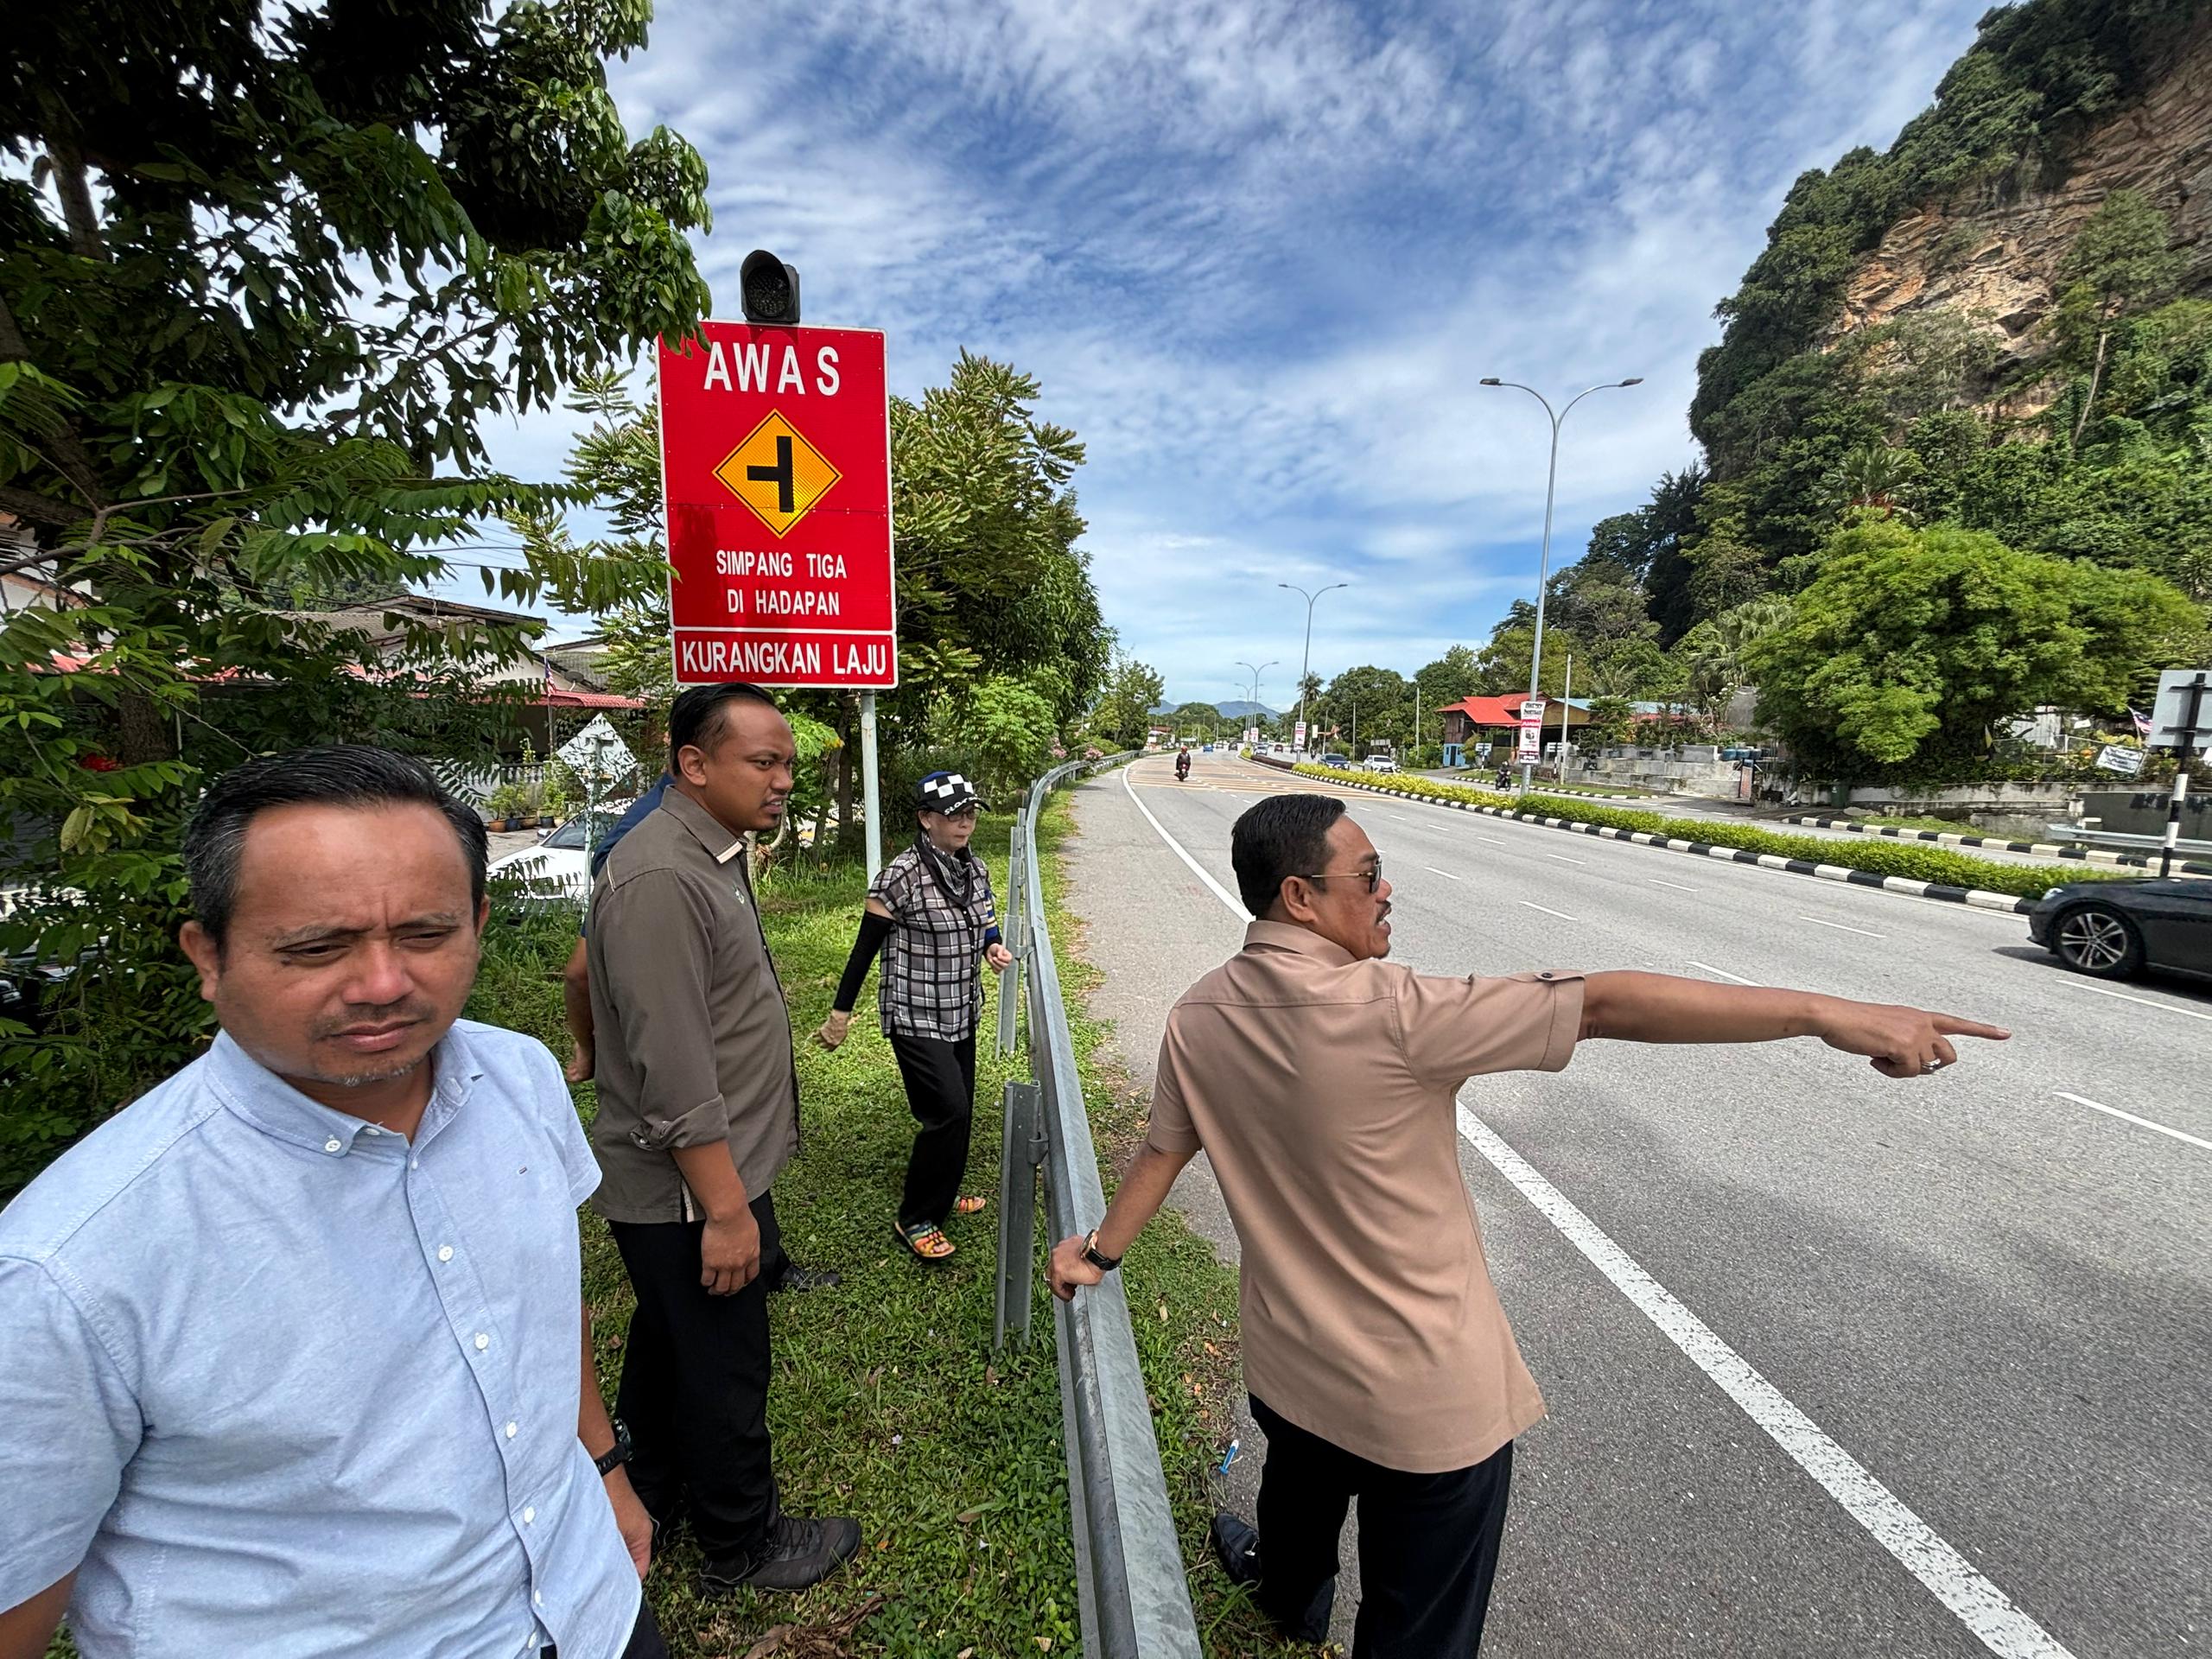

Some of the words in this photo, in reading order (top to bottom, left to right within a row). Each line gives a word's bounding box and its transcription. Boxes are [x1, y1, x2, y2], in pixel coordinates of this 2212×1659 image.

[703, 341, 840, 397] AWAS
[716, 550, 793, 577] SIMPANG
[805, 553, 848, 579] TIGA
[727, 588, 744, 613] DI
[755, 589, 840, 616] HADAPAN
[682, 640, 821, 674] KURANGKAN
[833, 644, 887, 676] LAJU
